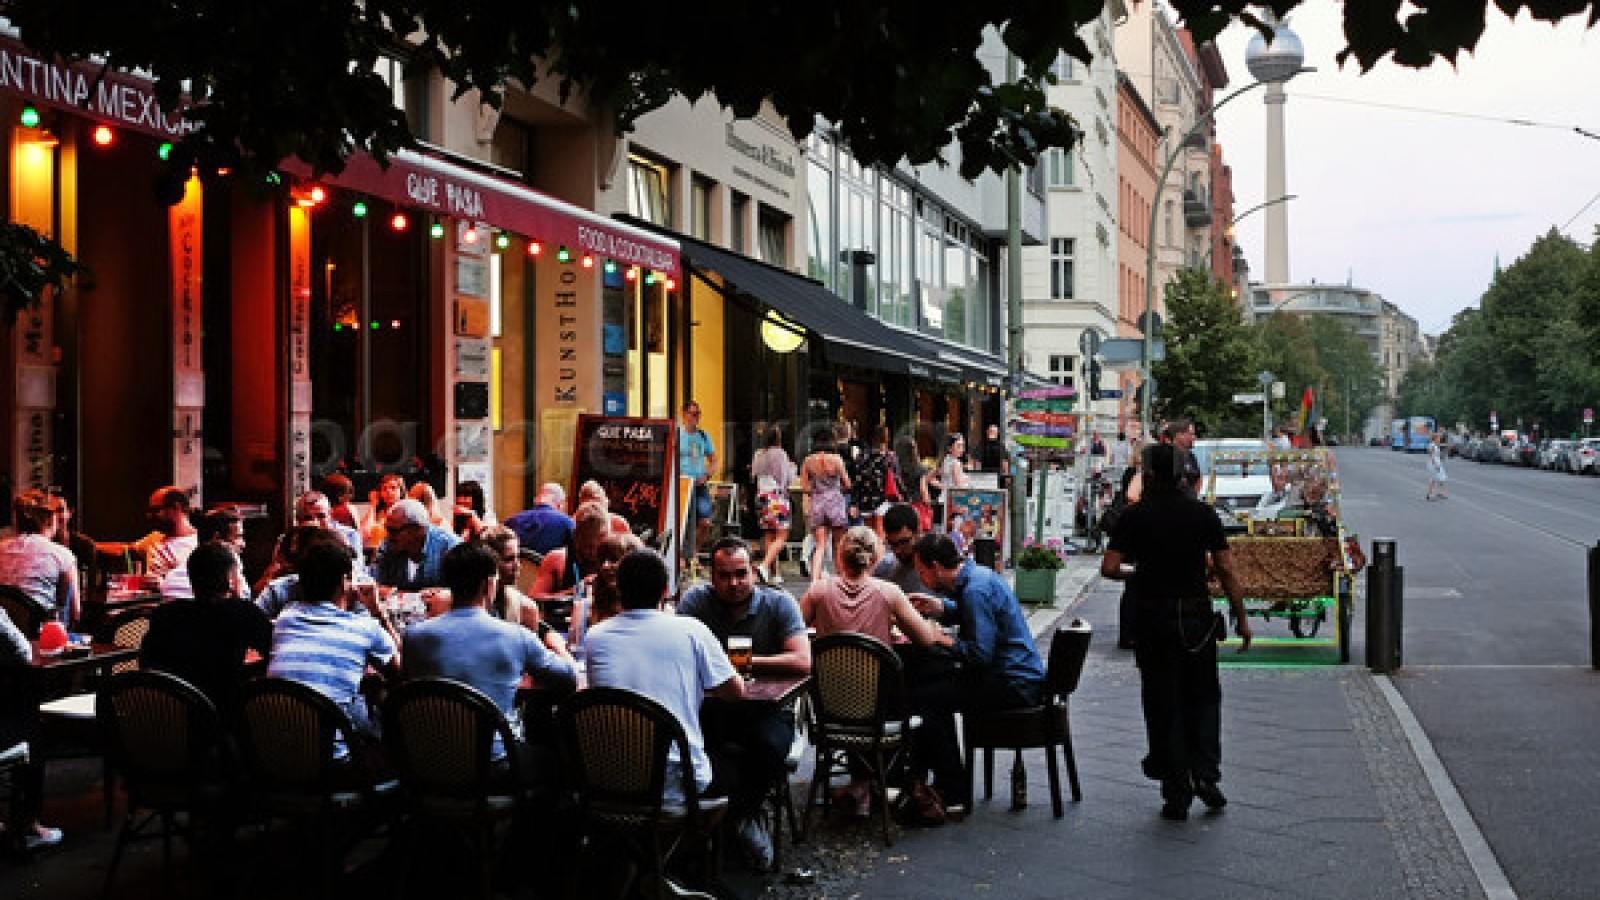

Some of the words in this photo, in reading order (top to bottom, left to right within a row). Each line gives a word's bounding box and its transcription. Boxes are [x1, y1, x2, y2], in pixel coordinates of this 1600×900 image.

[0, 50, 93, 109] NTINA
[446, 183, 486, 218] PASA
[578, 225, 606, 252] FOOD
